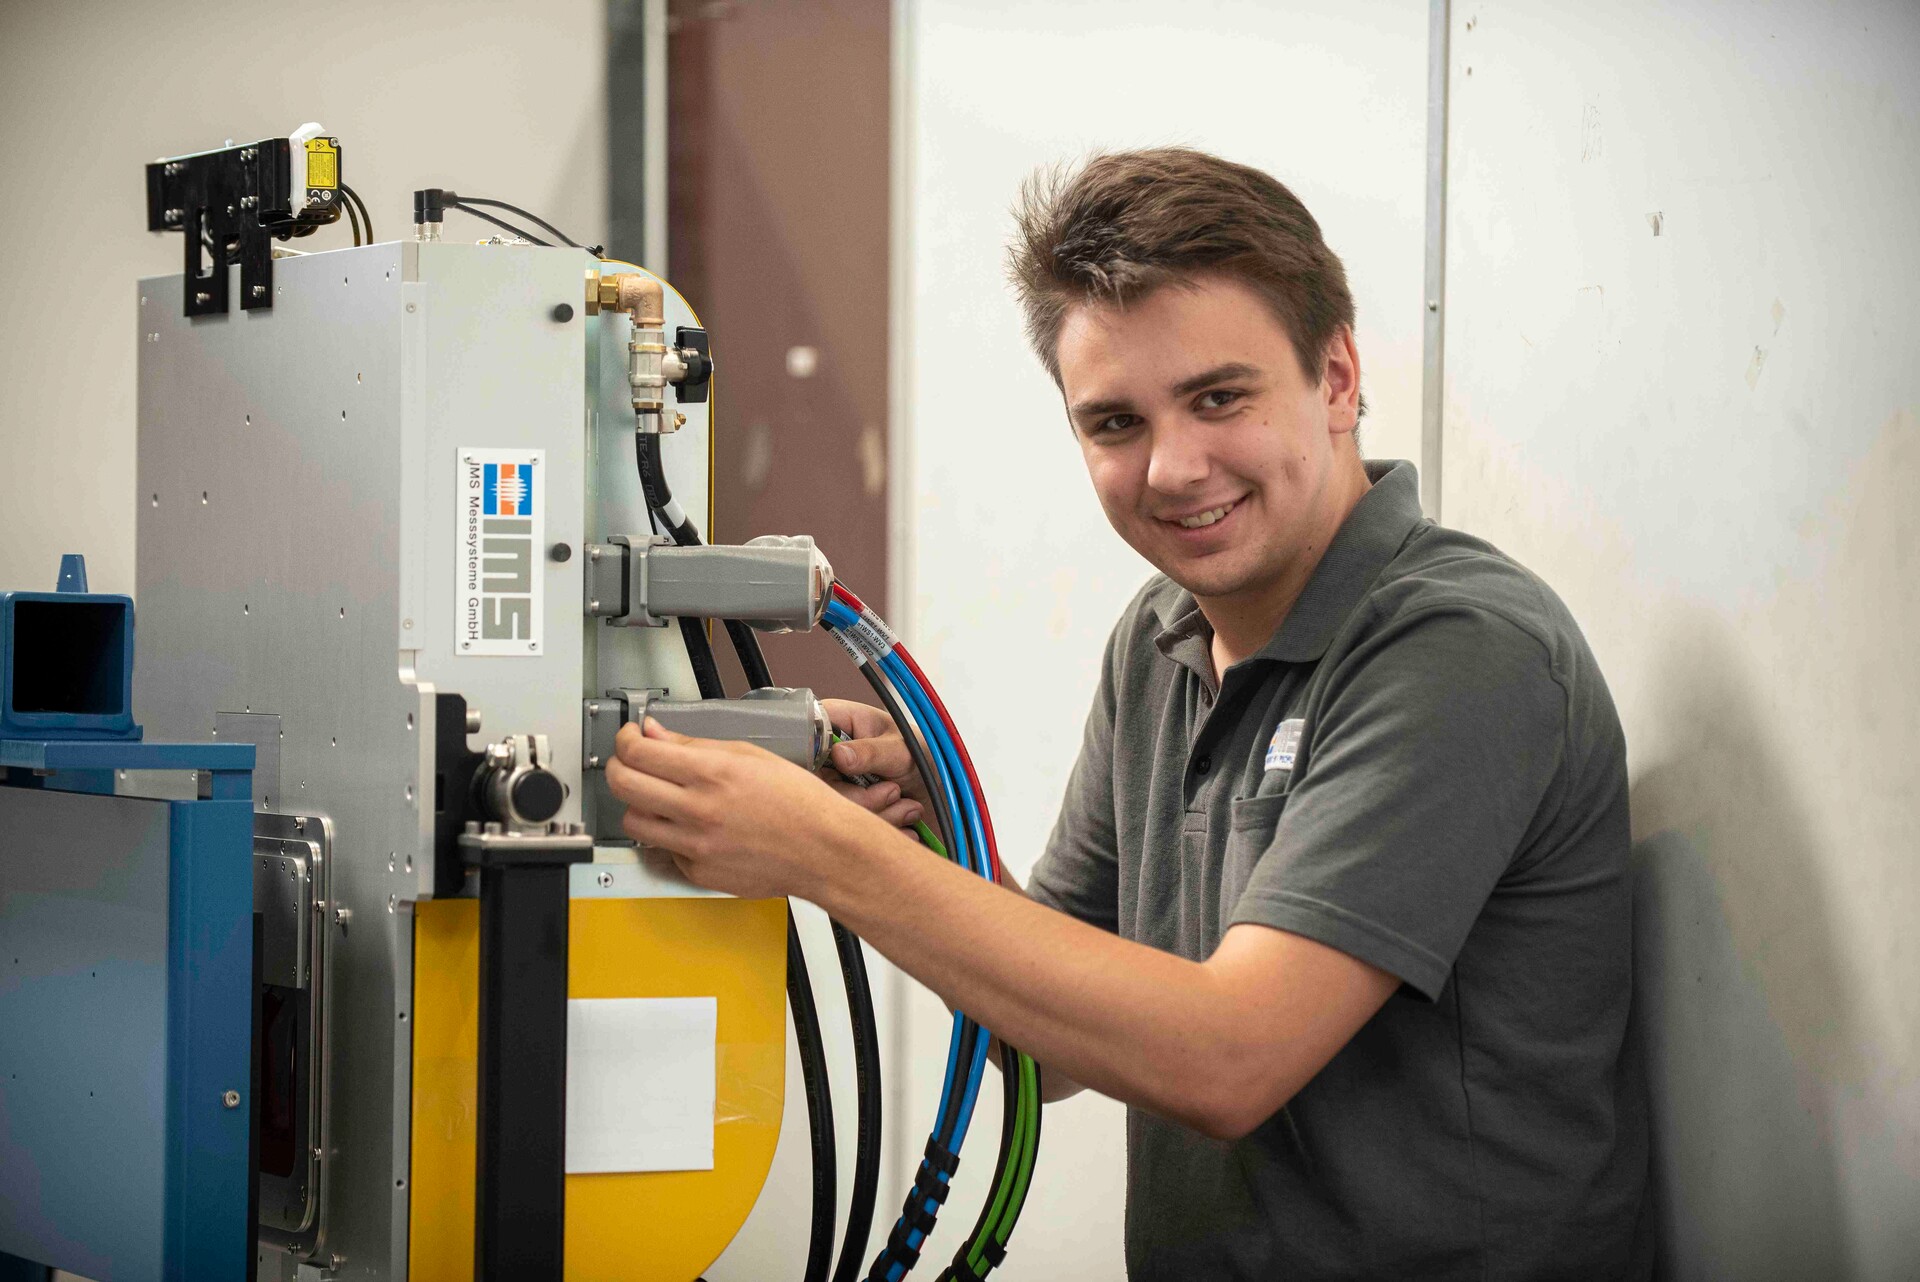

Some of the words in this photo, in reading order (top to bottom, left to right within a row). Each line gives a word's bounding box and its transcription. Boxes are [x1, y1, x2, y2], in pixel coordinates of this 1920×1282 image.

[466, 496, 480, 590] Messsysteme
[482, 519, 531, 640] IMS
[468, 597, 479, 640] GmbH
